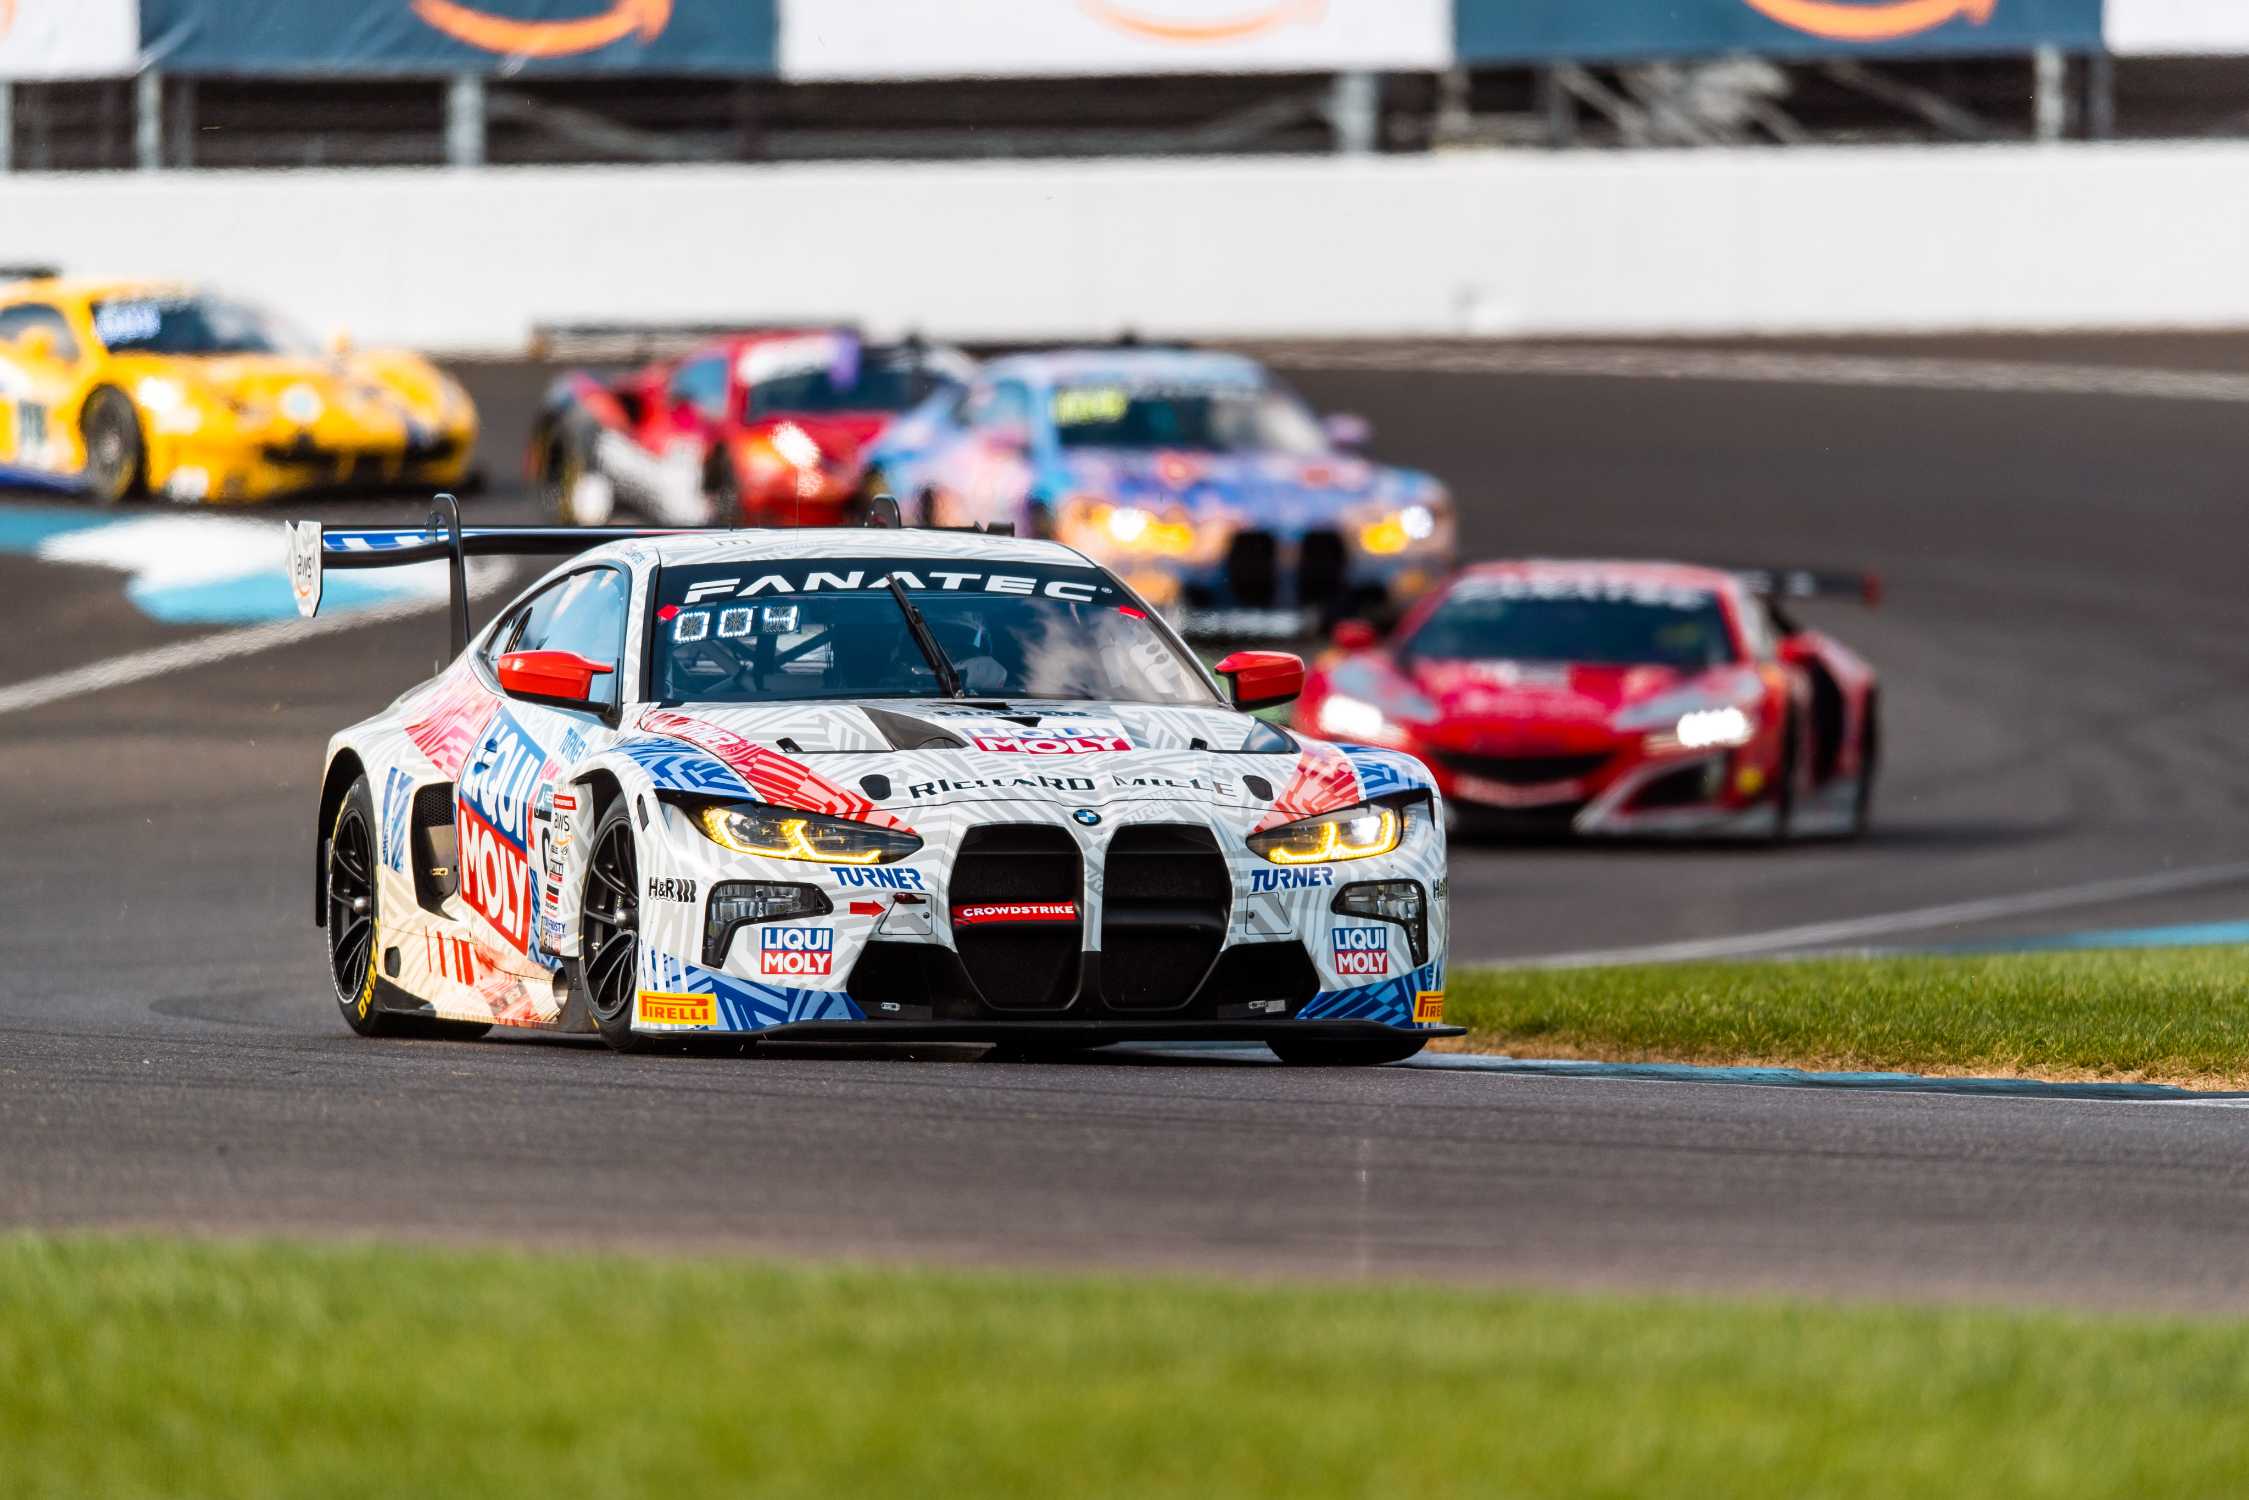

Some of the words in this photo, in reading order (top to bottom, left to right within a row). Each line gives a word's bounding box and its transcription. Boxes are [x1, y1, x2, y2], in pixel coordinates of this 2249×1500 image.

[684, 571, 1097, 604] FANATEC
[979, 738, 1131, 754] MOLY
[460, 809, 528, 941] MOLY
[830, 867, 925, 890] TURNER
[1251, 867, 1333, 892] TURNER
[649, 876, 675, 899] H&R
[963, 905, 1075, 917] CROWDSTRIKE
[764, 930, 830, 951] LIQUI
[1336, 929, 1385, 951] LIQUI
[764, 952, 831, 974] MOLY
[1338, 951, 1387, 974] MOLY
[641, 995, 709, 1020] PIRELLI
[1417, 995, 1443, 1018] PIRE
